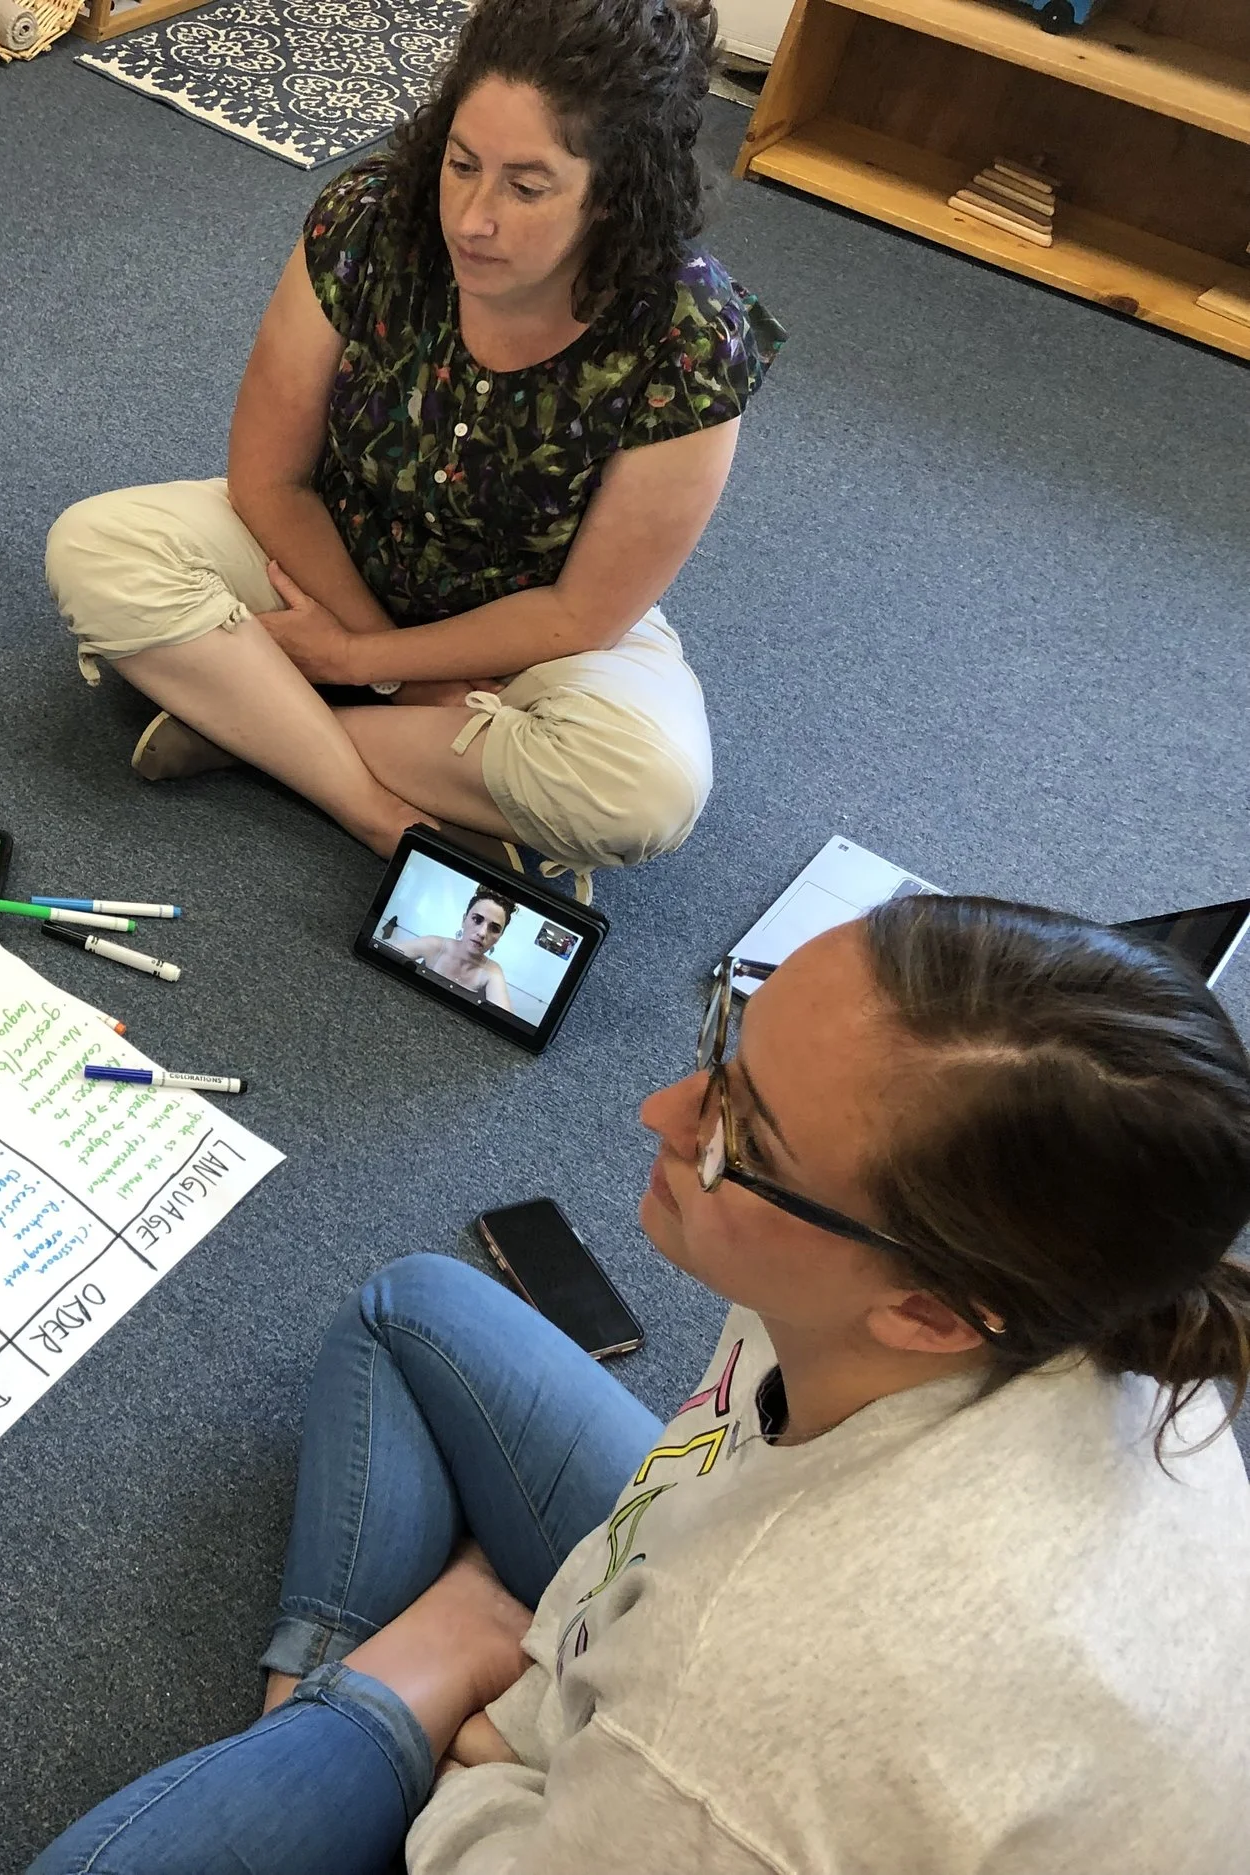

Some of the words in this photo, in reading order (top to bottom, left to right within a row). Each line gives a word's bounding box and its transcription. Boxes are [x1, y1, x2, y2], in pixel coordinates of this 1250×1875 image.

[71, 1055, 121, 1103] Reonses
[170, 1072, 223, 1084] COLORATIONS
[53, 1107, 70, 1119] to
[125, 1080, 157, 1119] object
[146, 1099, 180, 1129] realistic
[58, 1109, 97, 1148] picture
[177, 1111, 202, 1135] guide
[77, 1129, 111, 1165] object
[86, 1133, 146, 1194] representation
[143, 1154, 162, 1170] role
[163, 1139, 176, 1151] as
[135, 1138, 246, 1250] LANGUAGE
[34, 1225, 88, 1274] Classroom
[28, 1282, 106, 1354] ORDER
